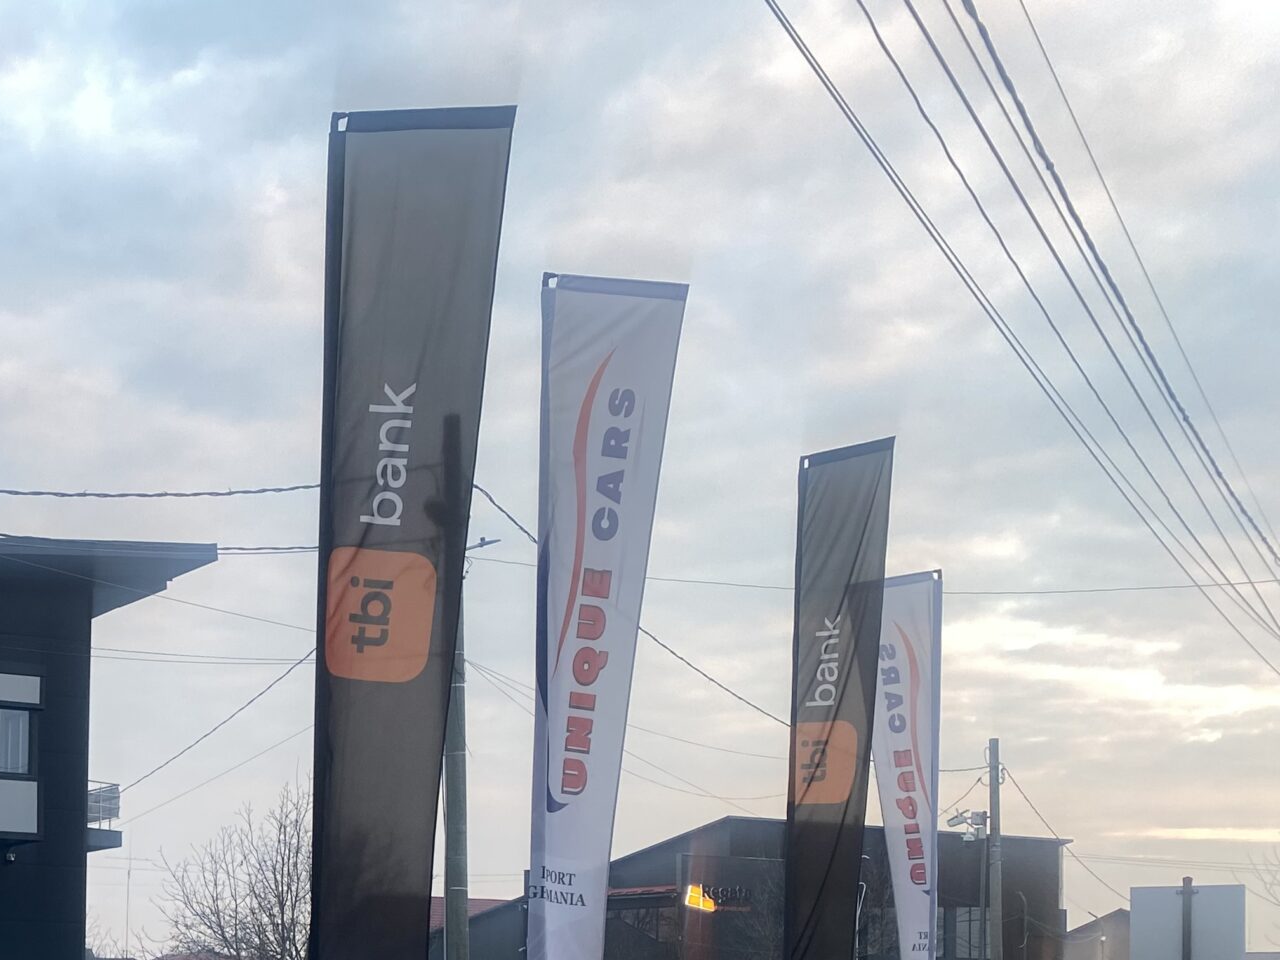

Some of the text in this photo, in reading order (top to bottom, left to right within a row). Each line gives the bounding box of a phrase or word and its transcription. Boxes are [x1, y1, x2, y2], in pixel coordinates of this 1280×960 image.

[348, 382, 418, 654] tbi bank
[561, 387, 636, 796] UNIQUE CARS
[801, 614, 842, 784] tbi bank
[541, 865, 577, 886] IPORT
